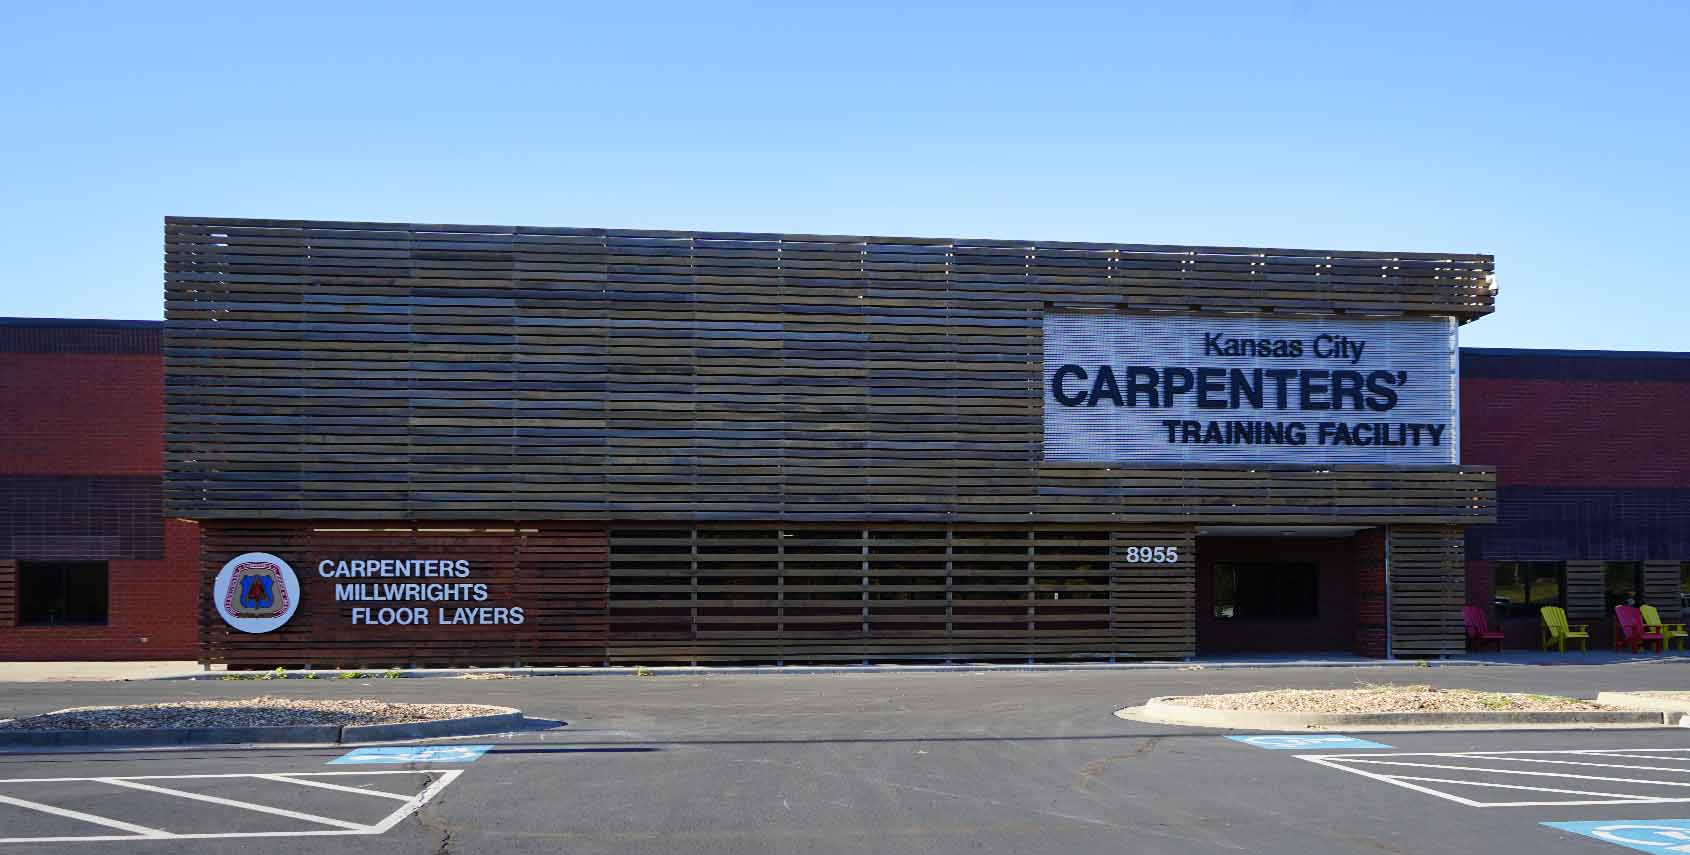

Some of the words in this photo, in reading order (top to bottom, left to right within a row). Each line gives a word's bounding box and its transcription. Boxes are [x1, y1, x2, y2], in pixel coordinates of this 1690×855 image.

[1204, 332, 1303, 358] Kansas
[1313, 333, 1365, 364] City
[1051, 364, 1407, 412] CARPENTERS'
[1163, 420, 1306, 445] TRAINING
[1318, 423, 1445, 447] FACILITY
[1126, 546, 1178, 563] 8955
[318, 559, 470, 578] CARPENTERS
[336, 583, 488, 601] MILLWRIGHTS
[352, 607, 428, 625] FLOOR
[439, 607, 525, 625] LAYERS
